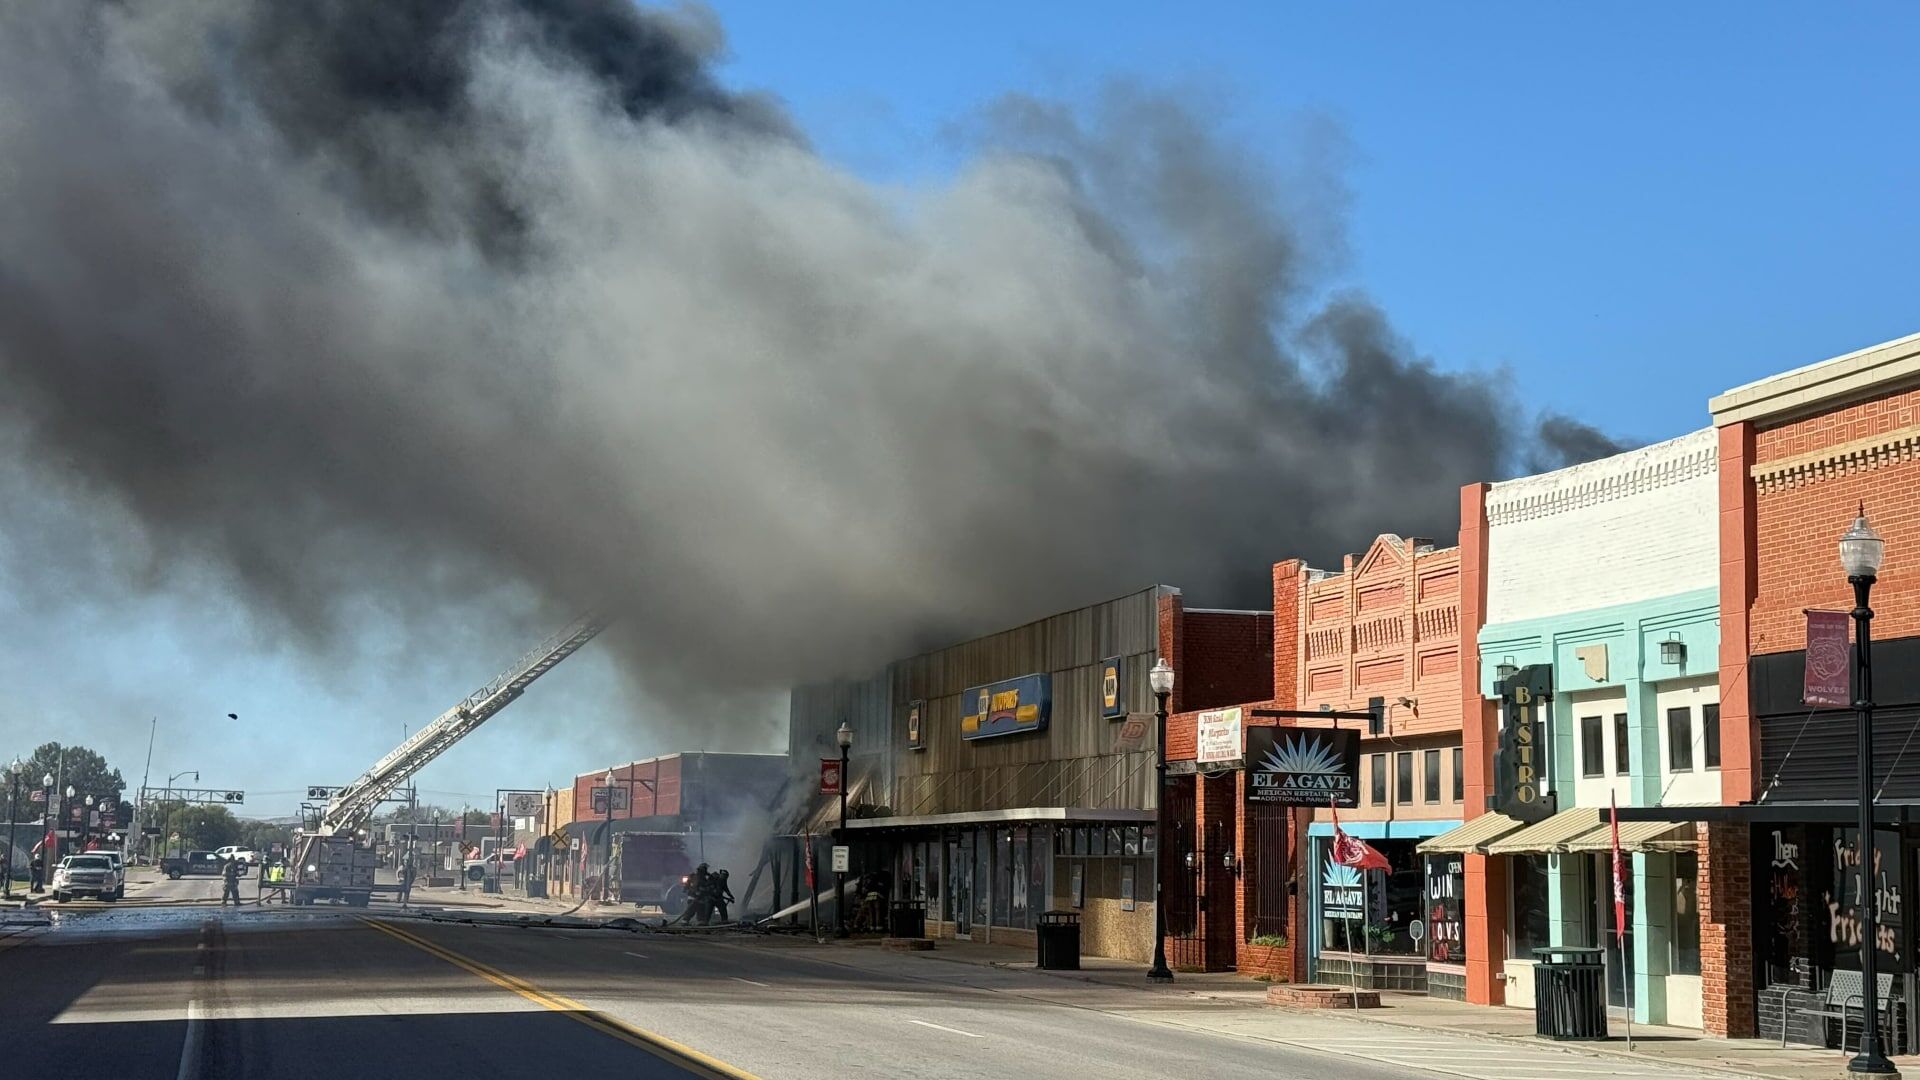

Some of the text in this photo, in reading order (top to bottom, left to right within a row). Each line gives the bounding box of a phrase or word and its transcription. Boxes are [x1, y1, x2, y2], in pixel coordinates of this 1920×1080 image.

[1808, 685, 1845, 694] WOLVES
[1515, 686, 1536, 804] BISTRO
[1252, 773, 1351, 789] EL AGAVE
[1257, 789, 1293, 797] MEXICAN
[1835, 833, 1881, 876] Fridy
[1448, 862, 1462, 873] OPEN
[1430, 873, 1453, 899] WIN
[1324, 888, 1363, 906] EL AGAVE
